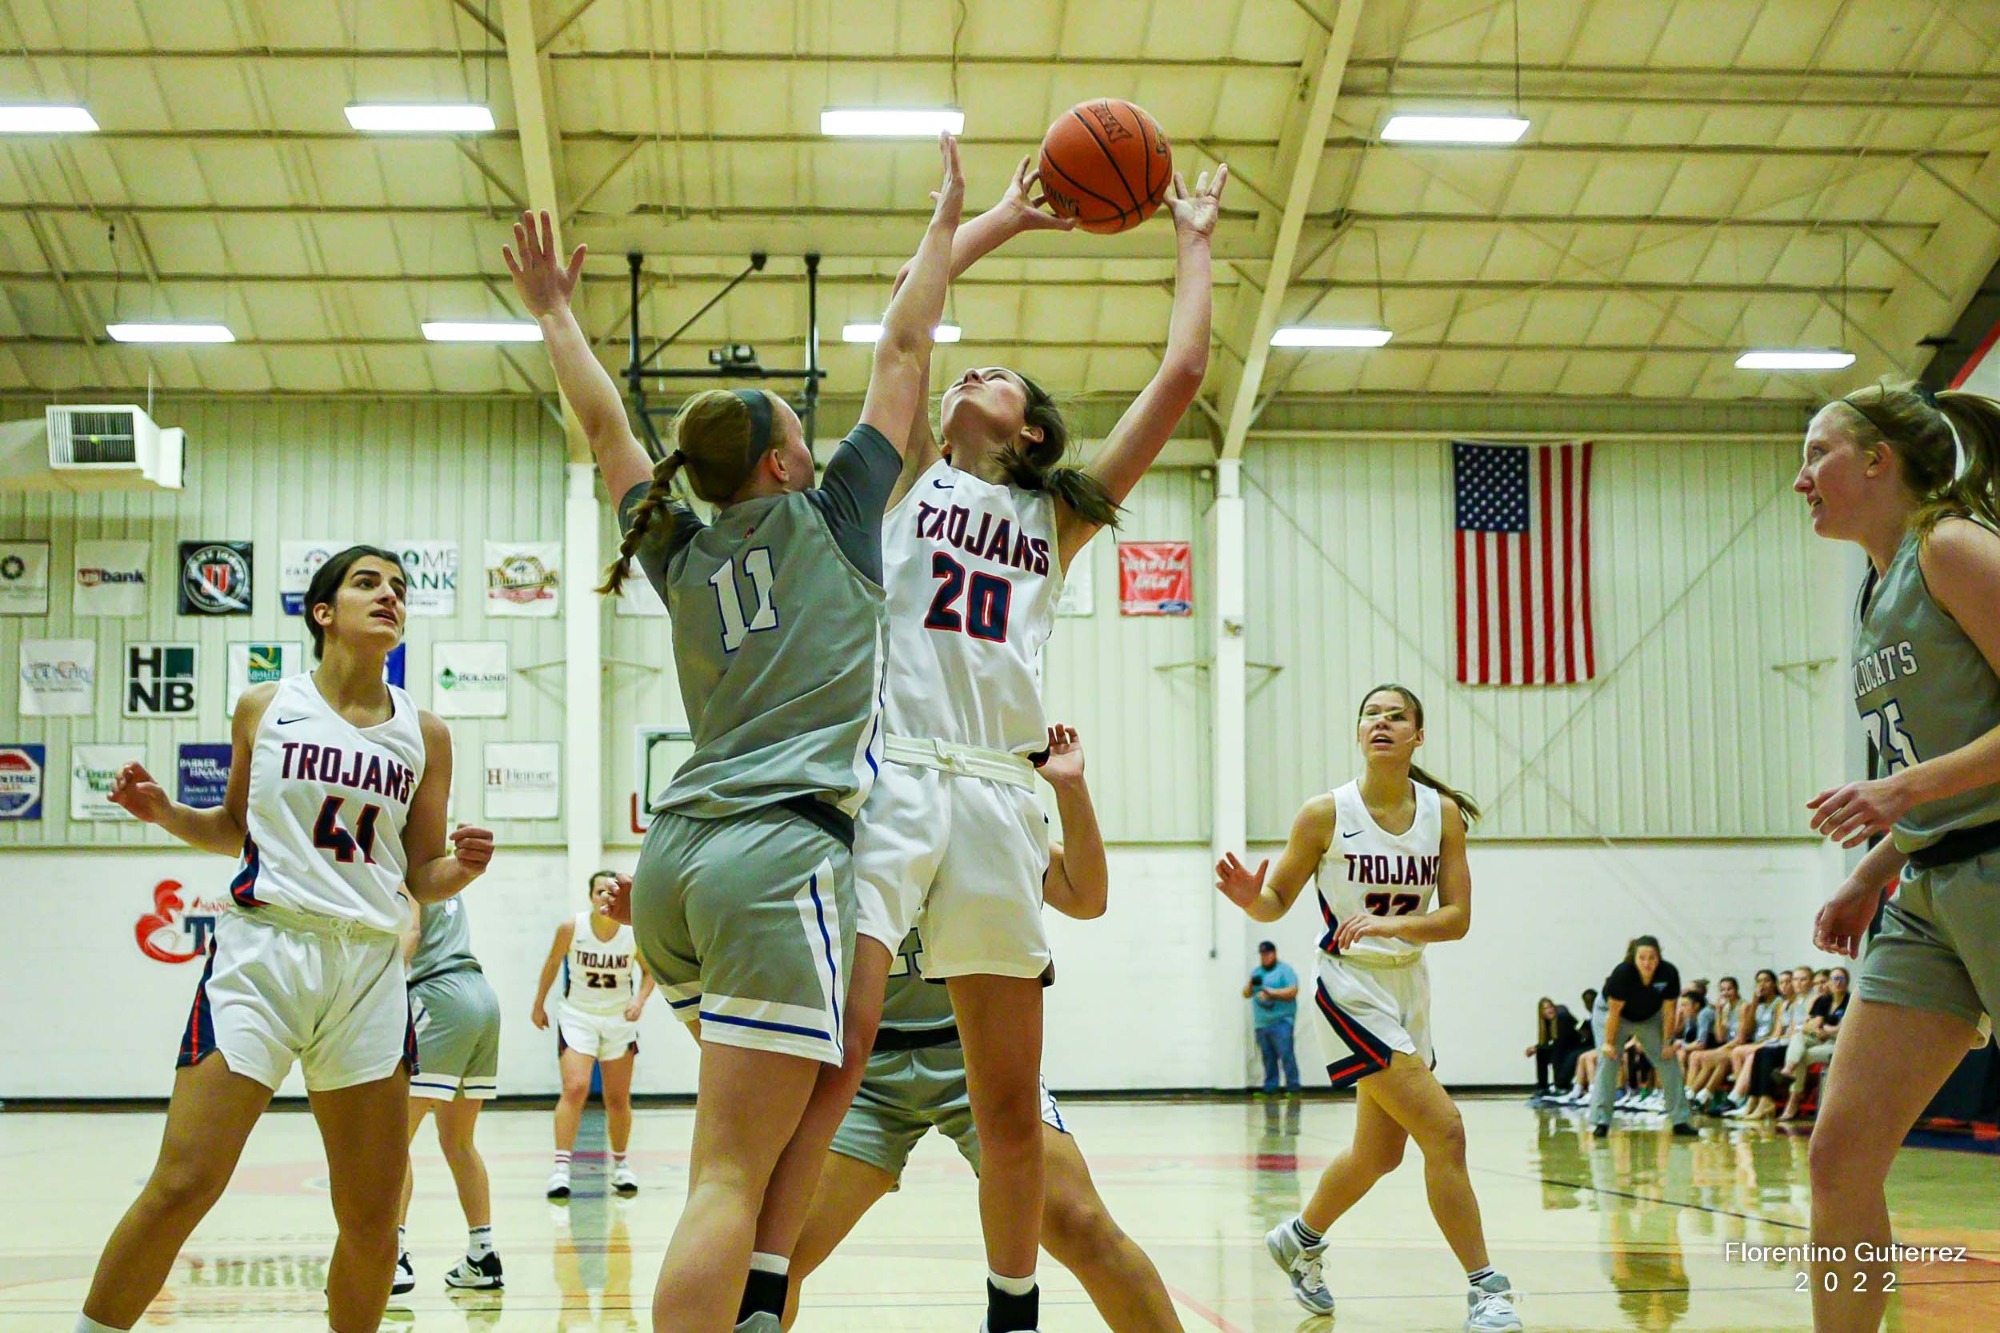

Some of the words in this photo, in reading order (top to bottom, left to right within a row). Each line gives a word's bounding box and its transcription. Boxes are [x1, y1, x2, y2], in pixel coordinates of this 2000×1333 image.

[402, 549, 458, 568] OME
[916, 501, 1049, 577] TROJANS
[405, 571, 458, 590] ANK
[708, 546, 779, 654] 11
[924, 551, 1012, 643] 20
[1853, 640, 1919, 699] LDCATS
[282, 743, 415, 805] TROJANS
[1344, 854, 1440, 886] TROJANS
[575, 950, 630, 969] TROJANS
[586, 972, 617, 989] 23
